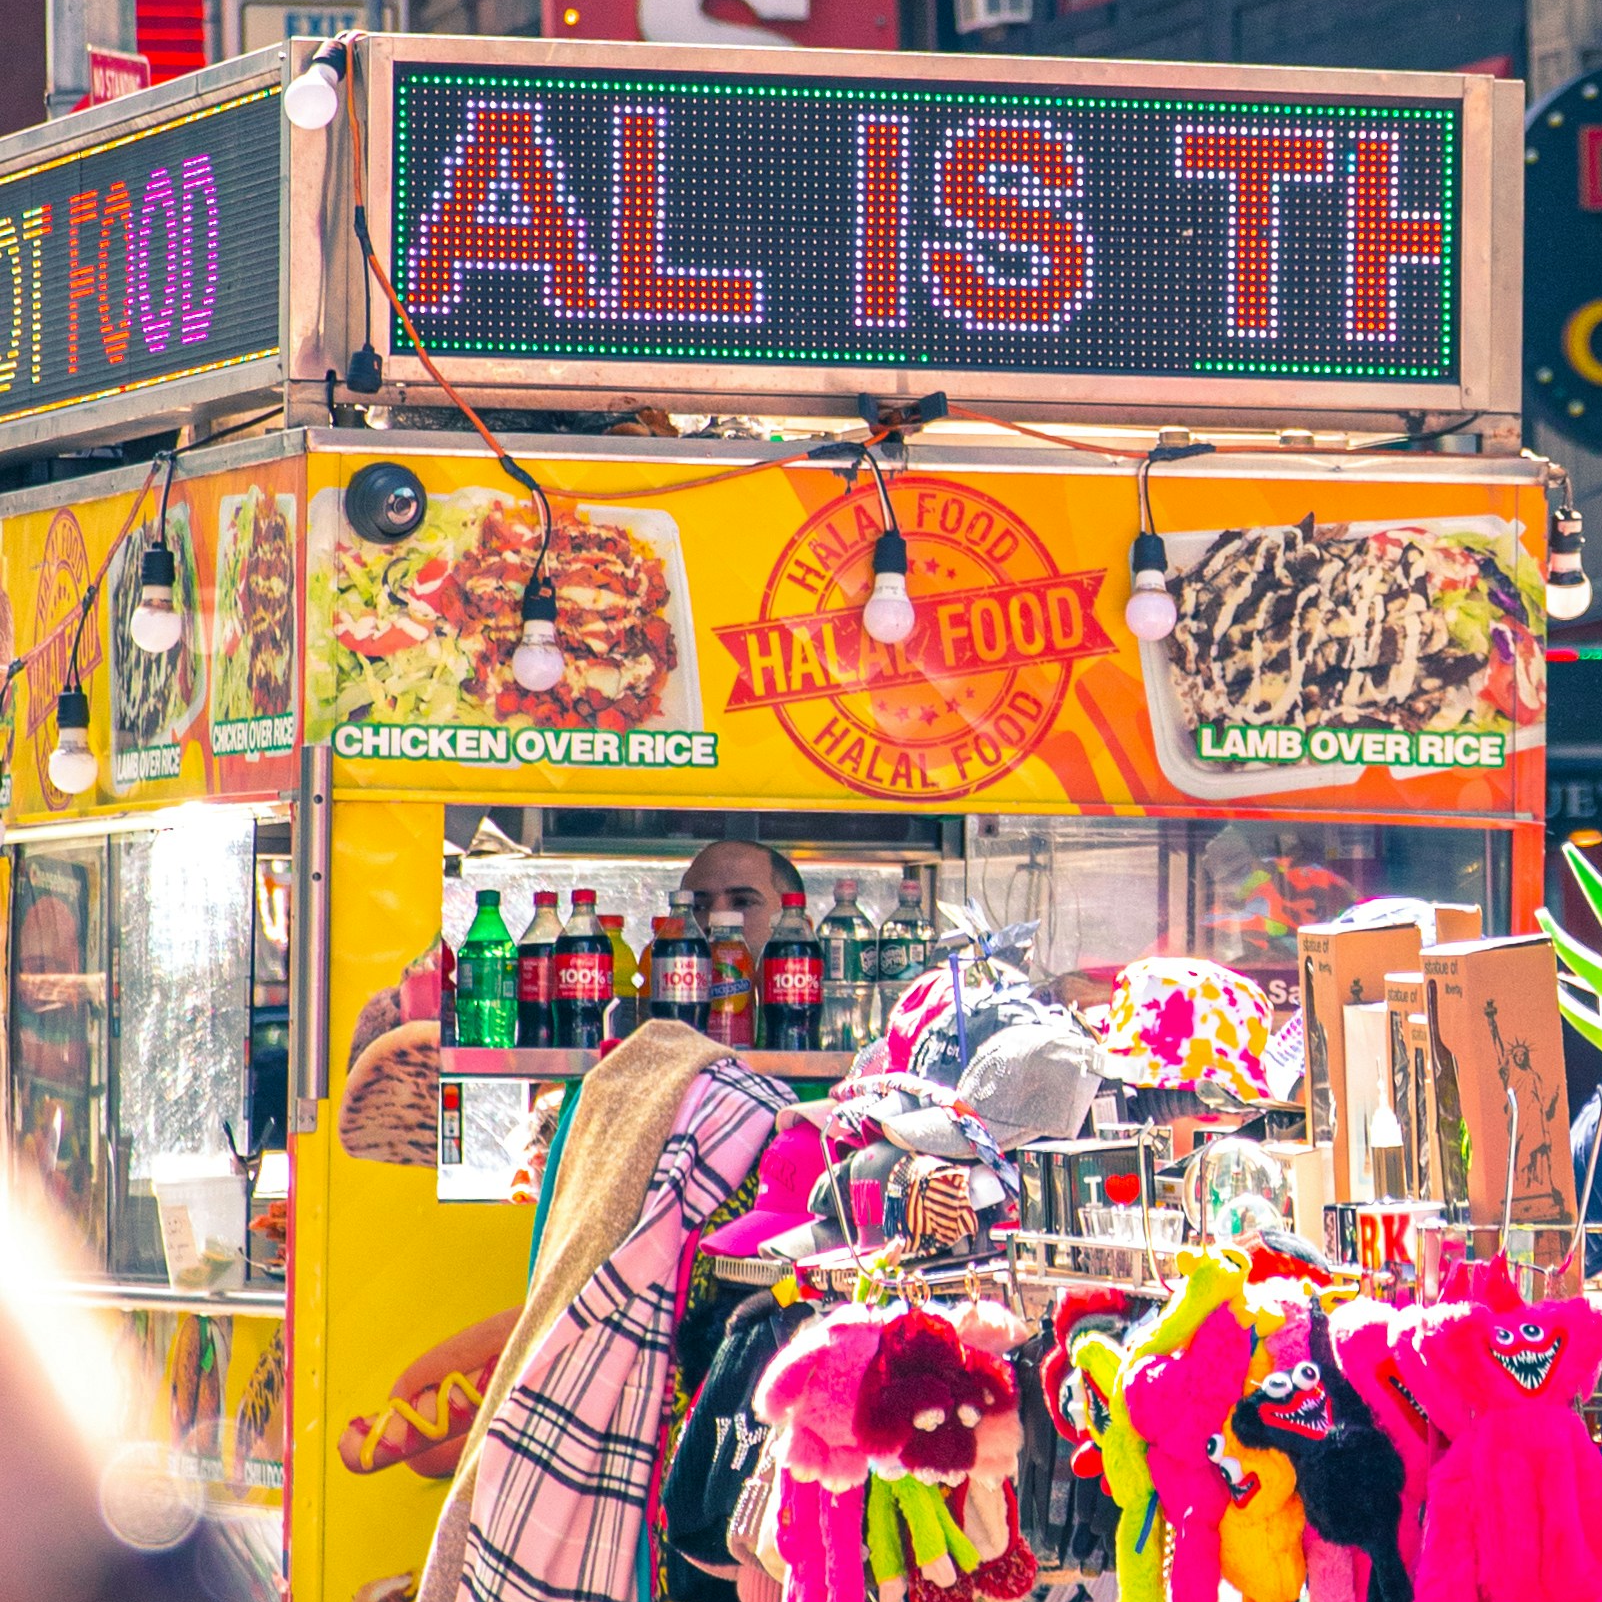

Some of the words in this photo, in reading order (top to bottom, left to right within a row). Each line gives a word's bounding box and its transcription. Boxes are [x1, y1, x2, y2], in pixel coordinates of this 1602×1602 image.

[285, 12, 357, 37] EXIT
[407, 100, 765, 324] AL
[853, 113, 1094, 334] IS
[67, 153, 218, 376] FOOD
[785, 501, 902, 596] HALA
[916, 492, 1021, 565] FOOD
[937, 586, 1083, 668] FOOD
[213, 720, 248, 754] CHICKEN
[249, 716, 274, 749] OVER
[274, 713, 295, 746] RICE
[335, 724, 506, 764] CHICKEN
[515, 728, 621, 766] OVER
[626, 731, 717, 767] RICE
[812, 716, 940, 790] HALAL
[950, 689, 1045, 782] FOOD
[1200, 726, 1303, 761] LAMB
[1309, 729, 1411, 764] OVER
[1416, 733, 1505, 766] RICE
[116, 749, 138, 783] LAMB
[138, 747, 162, 781] OVER
[161, 744, 181, 776] RICE
[558, 967, 606, 986] 100%
[662, 972, 708, 988] 100%
[773, 972, 820, 989] 100%
[1424, 961, 1449, 975] statue
[1450, 959, 1459, 975] of
[709, 978, 751, 997] napple
[1386, 988, 1410, 1002] statue
[1411, 990, 1418, 1003] of
[1411, 1028, 1427, 1042] statu
